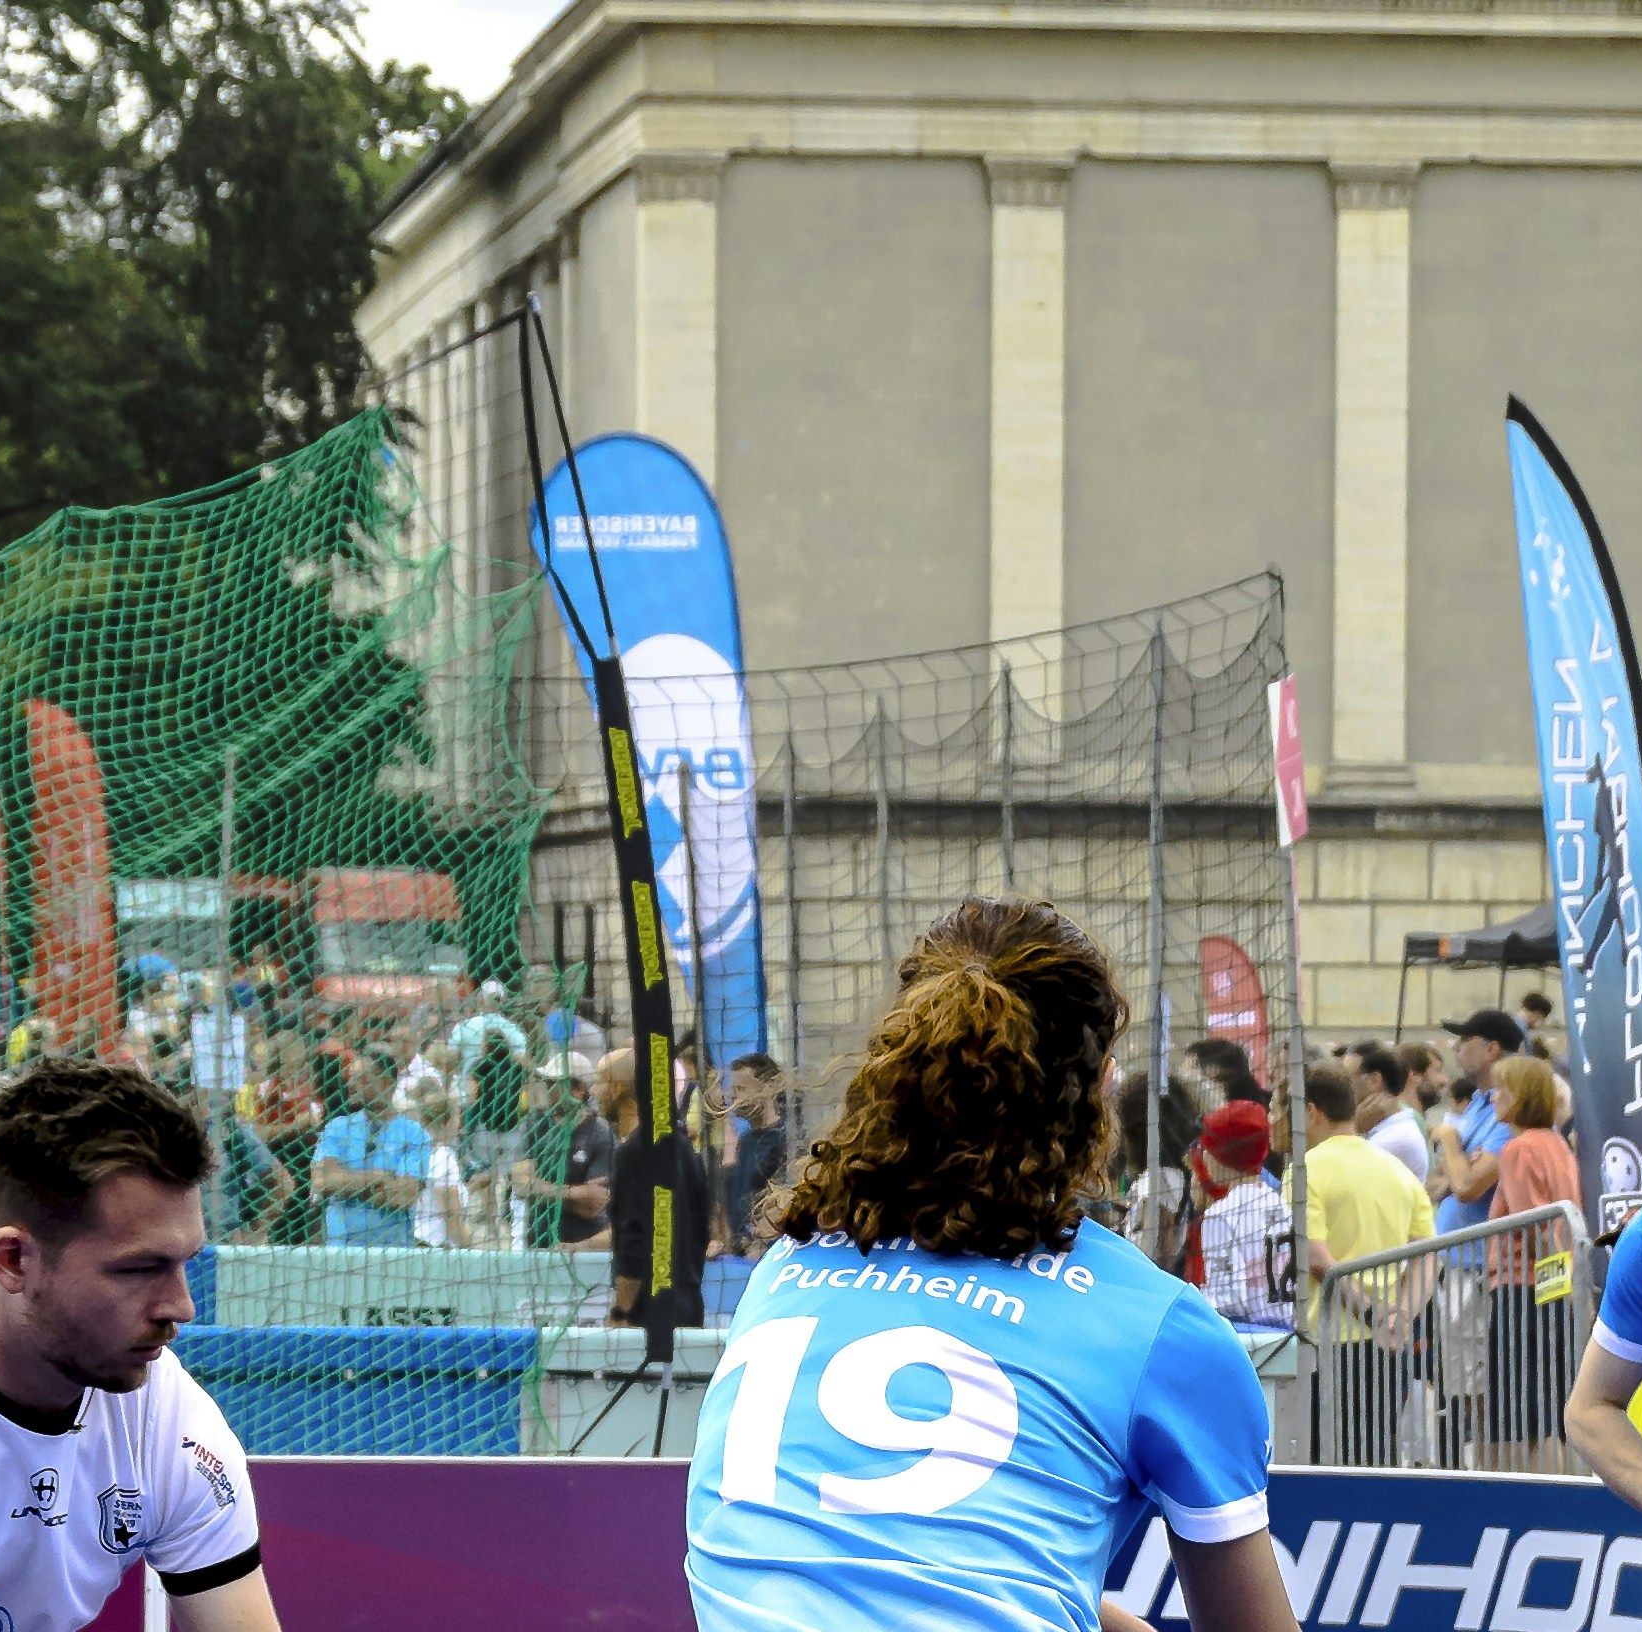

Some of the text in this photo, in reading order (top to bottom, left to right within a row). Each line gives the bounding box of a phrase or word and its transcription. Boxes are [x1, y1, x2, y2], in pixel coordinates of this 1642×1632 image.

[632, 882, 660, 981] POWERSHOT
[652, 1035, 670, 1134] POWERSHOT
[653, 1187, 671, 1288] POWERSHOT
[768, 1263, 1026, 1326] Puchheim
[712, 1316, 1020, 1515] 19
